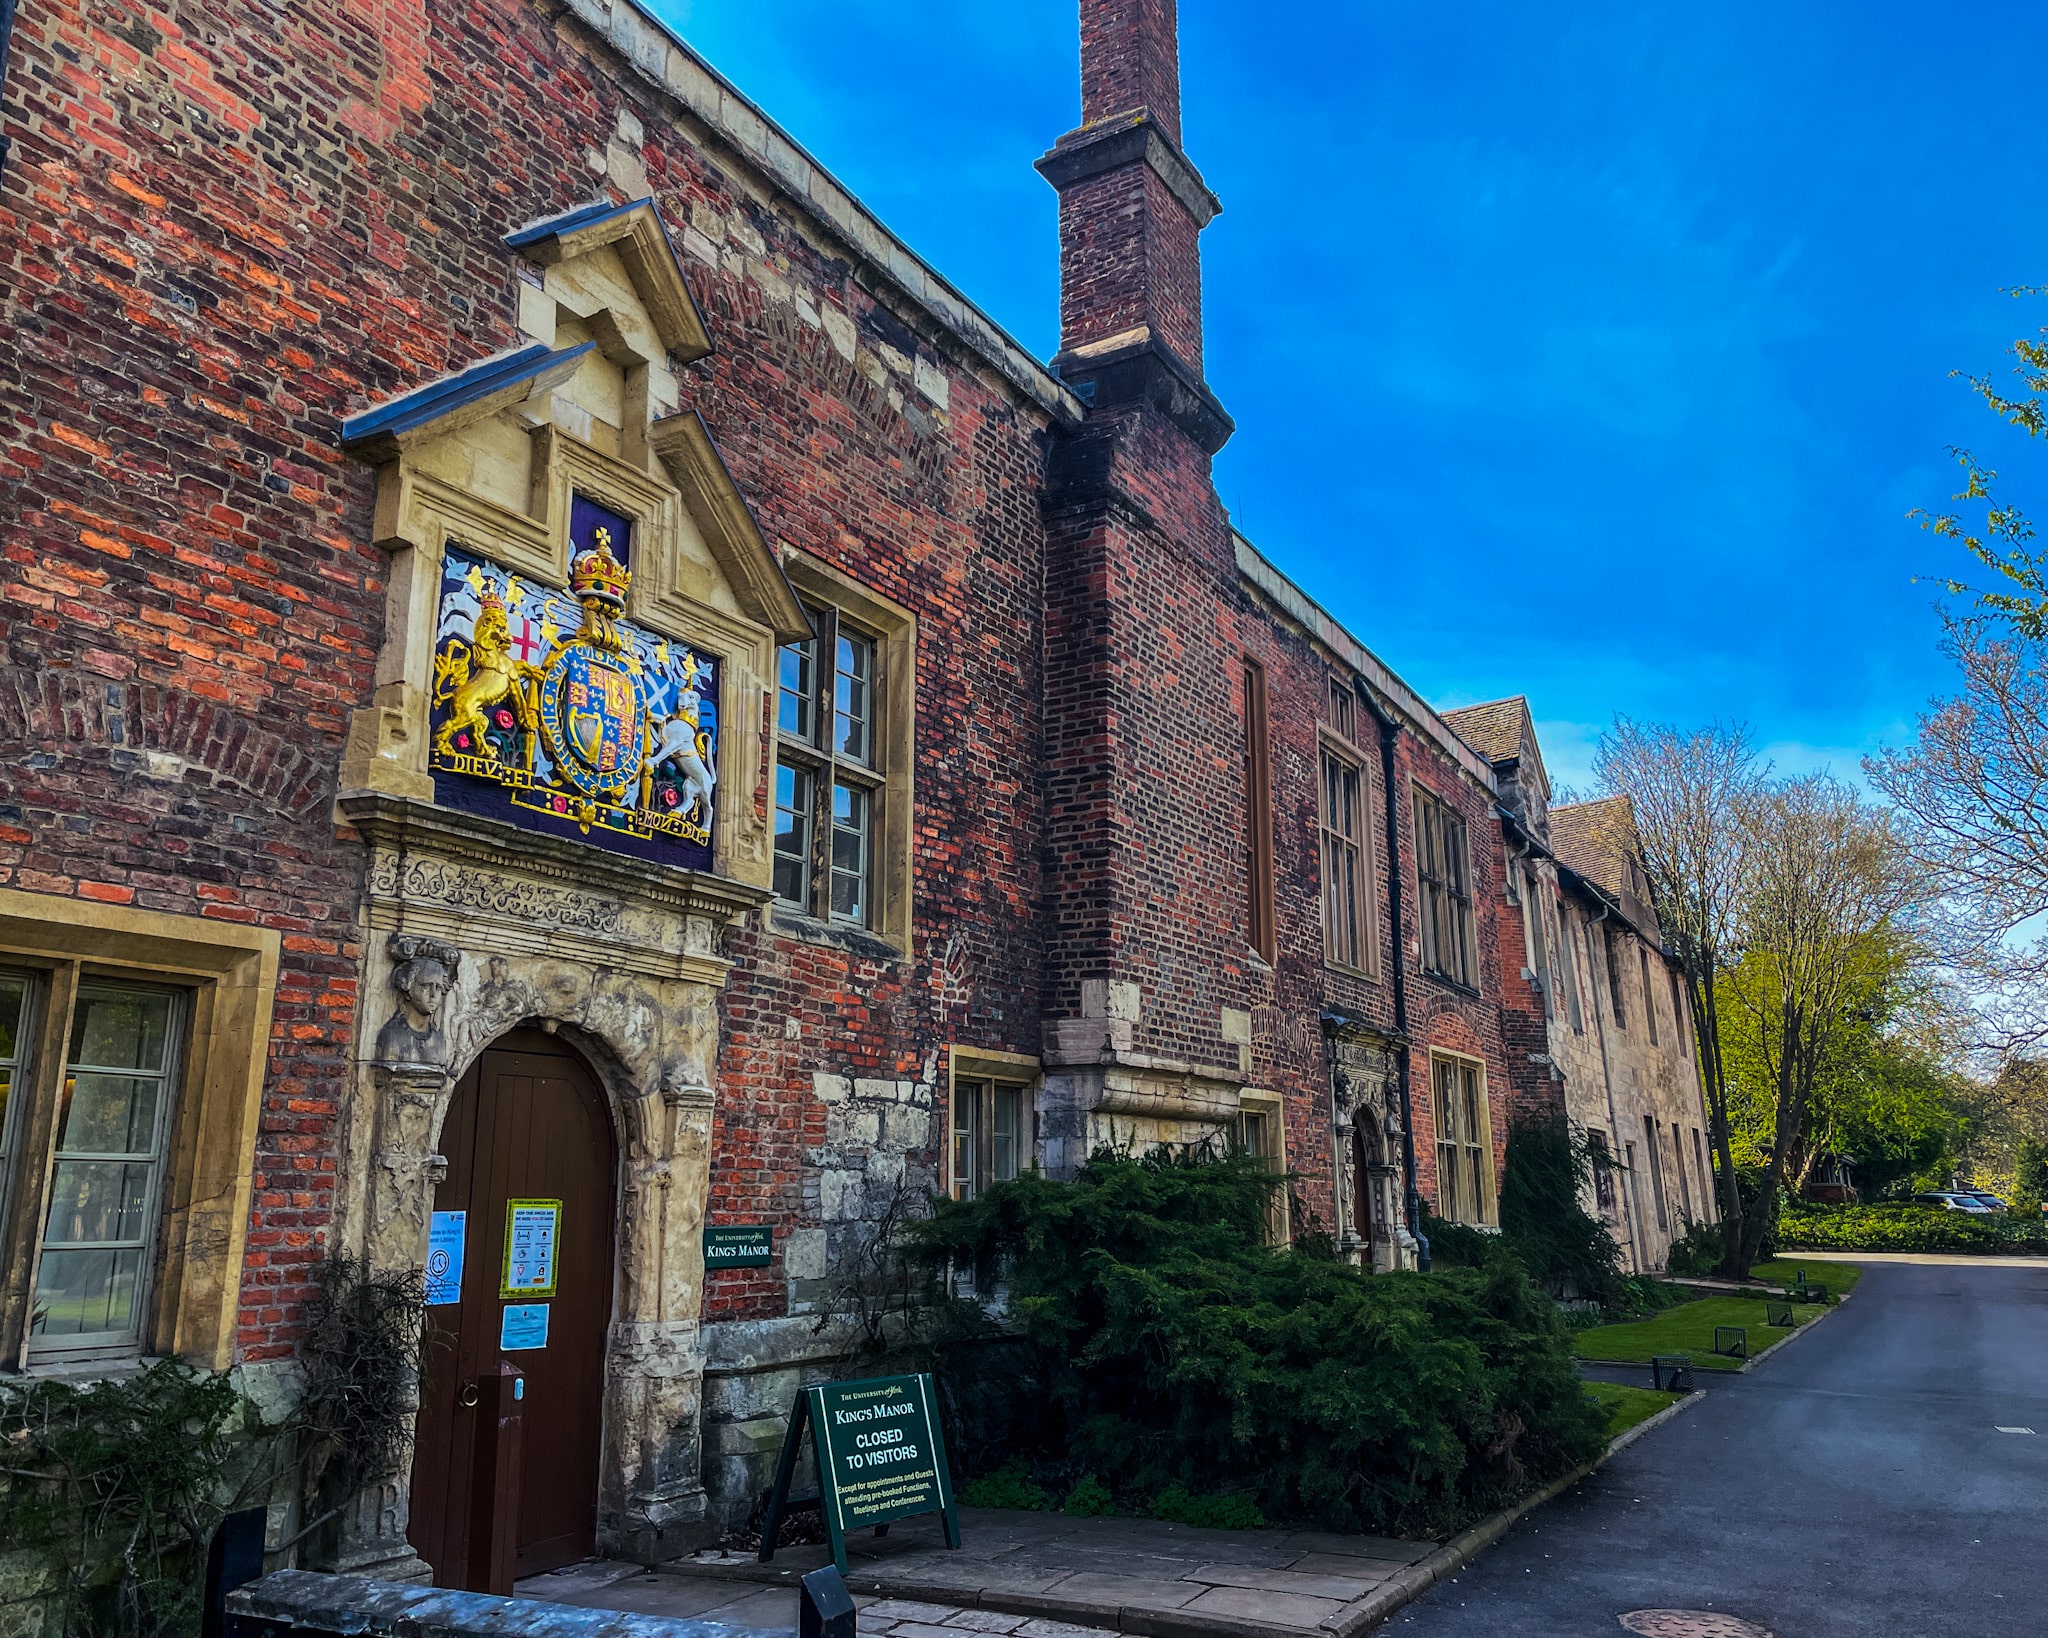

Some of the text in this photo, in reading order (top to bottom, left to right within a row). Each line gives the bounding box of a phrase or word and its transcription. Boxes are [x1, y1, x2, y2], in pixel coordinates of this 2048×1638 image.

[707, 1244, 769, 1257] KING'S MANOR
[853, 1389, 885, 1400] UNIVERSITY
[835, 1403, 915, 1425] KING'S MANOR
[856, 1428, 903, 1448] CLOSED
[846, 1444, 918, 1470] TO VISITORS
[838, 1469, 934, 1494] Except for appointments and Guests
[844, 1493, 872, 1505] attending
[871, 1487, 903, 1501] pre-booked
[853, 1503, 879, 1515] Meetings
[880, 1500, 891, 1509] and
